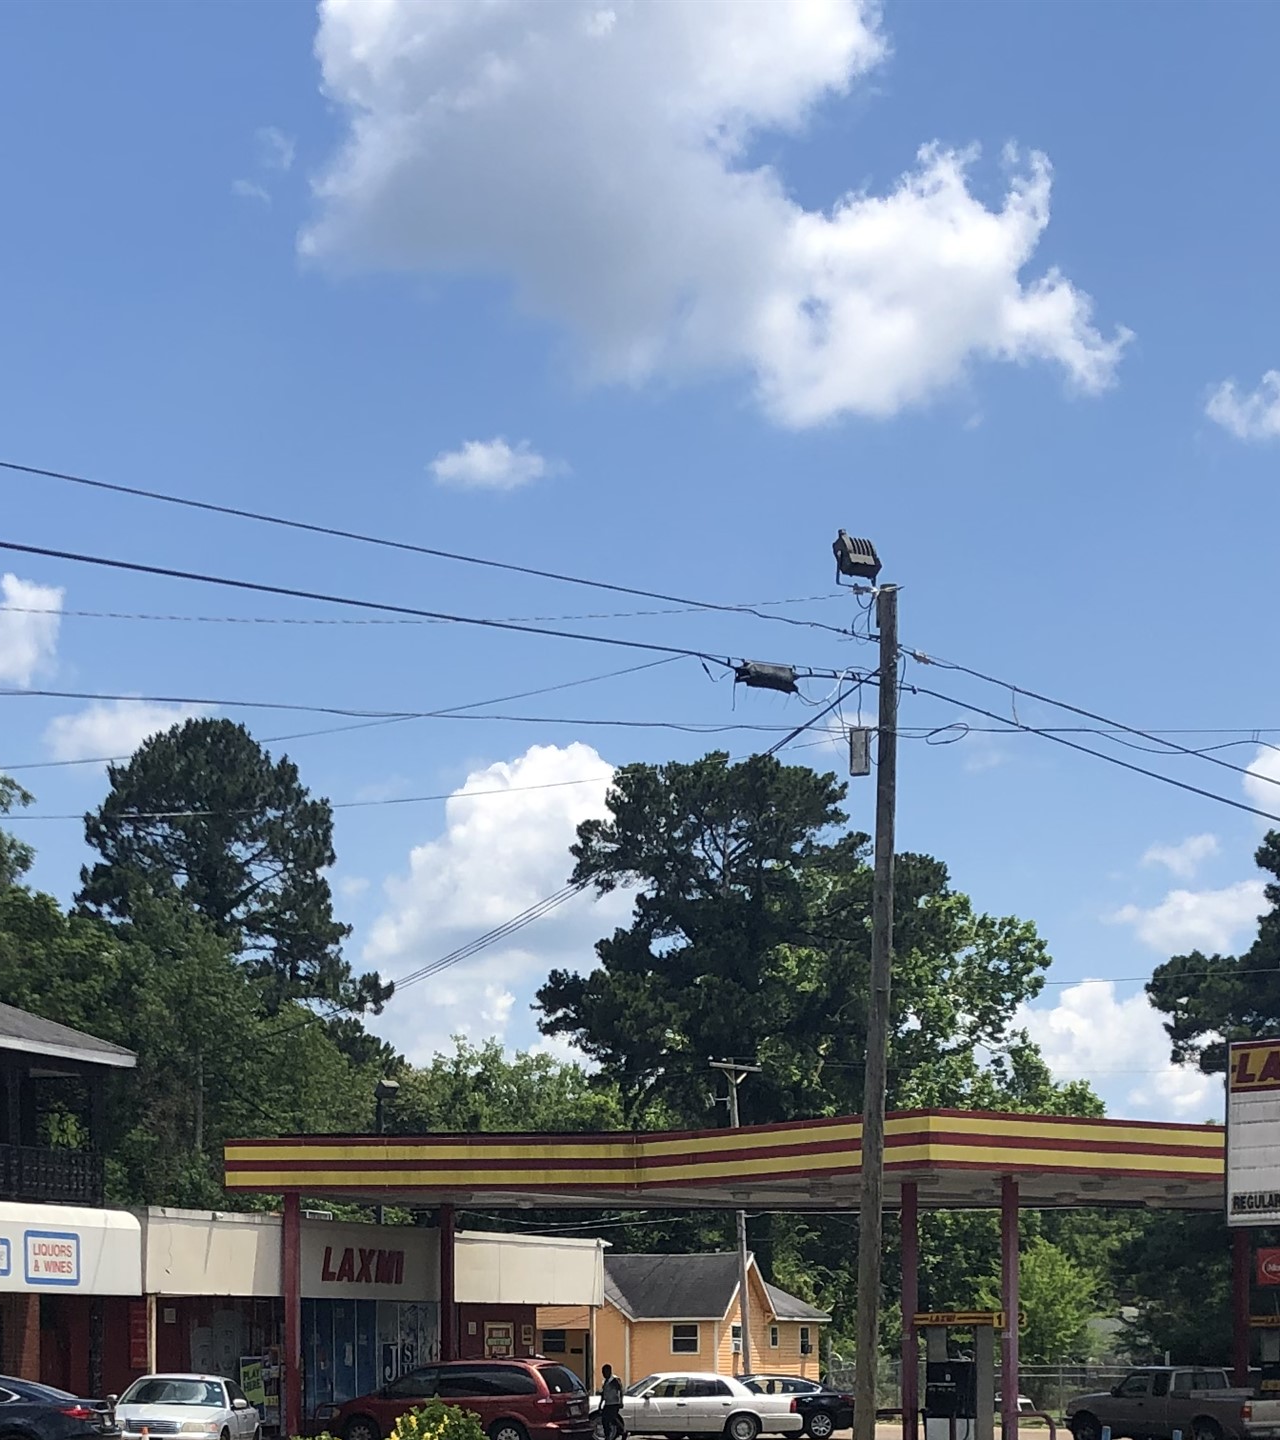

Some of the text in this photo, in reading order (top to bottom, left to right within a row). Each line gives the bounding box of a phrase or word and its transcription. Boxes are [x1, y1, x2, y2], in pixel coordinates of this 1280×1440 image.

[32, 1243, 73, 1258] LIQUORS
[33, 1259, 73, 1274] & WINES
[321, 1246, 405, 1285] LAXMI
[996, 1313, 1003, 1328] 1
[242, 1368, 261, 1380] PLAY
[243, 1380, 261, 1393] HERE
